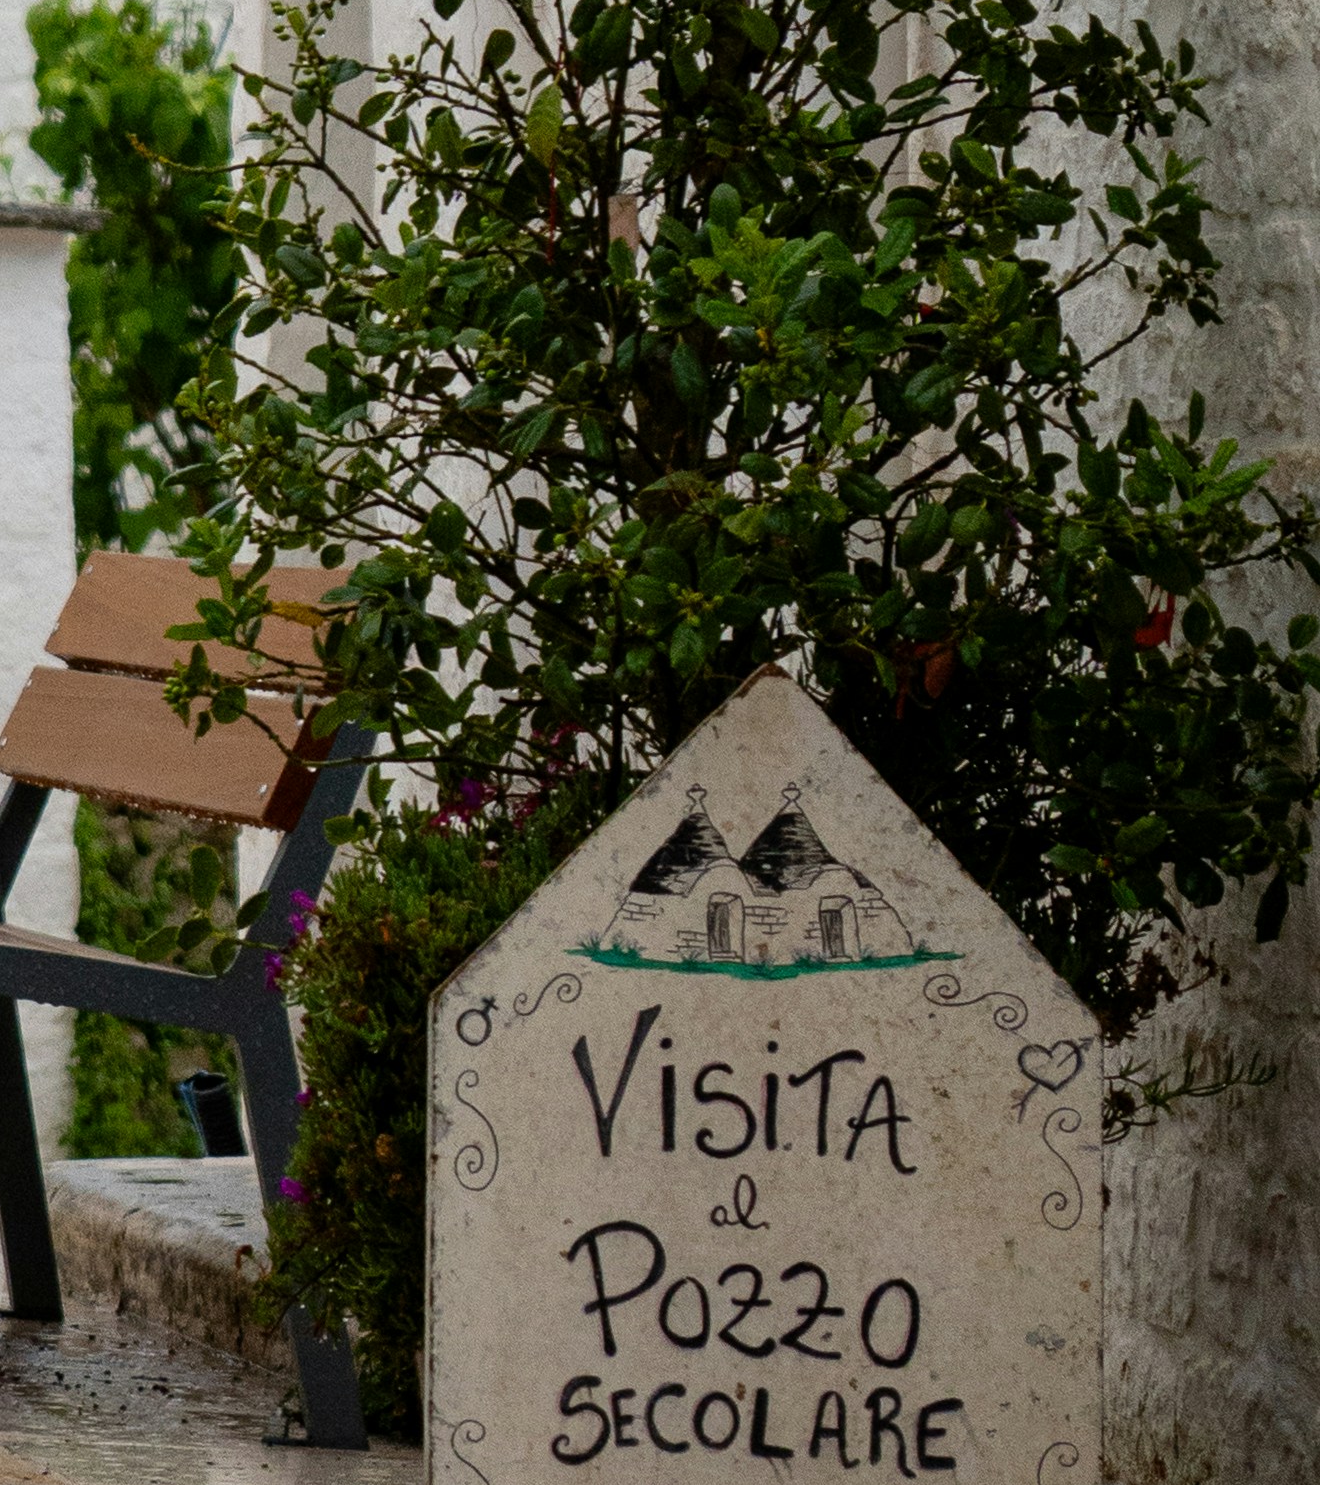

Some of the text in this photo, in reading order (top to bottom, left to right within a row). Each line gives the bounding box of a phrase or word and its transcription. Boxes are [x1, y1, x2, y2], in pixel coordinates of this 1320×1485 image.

[710, 1174, 769, 1230] al
[566, 1220, 921, 1369] POZZO
[551, 1375, 964, 1479] SECOLARE
